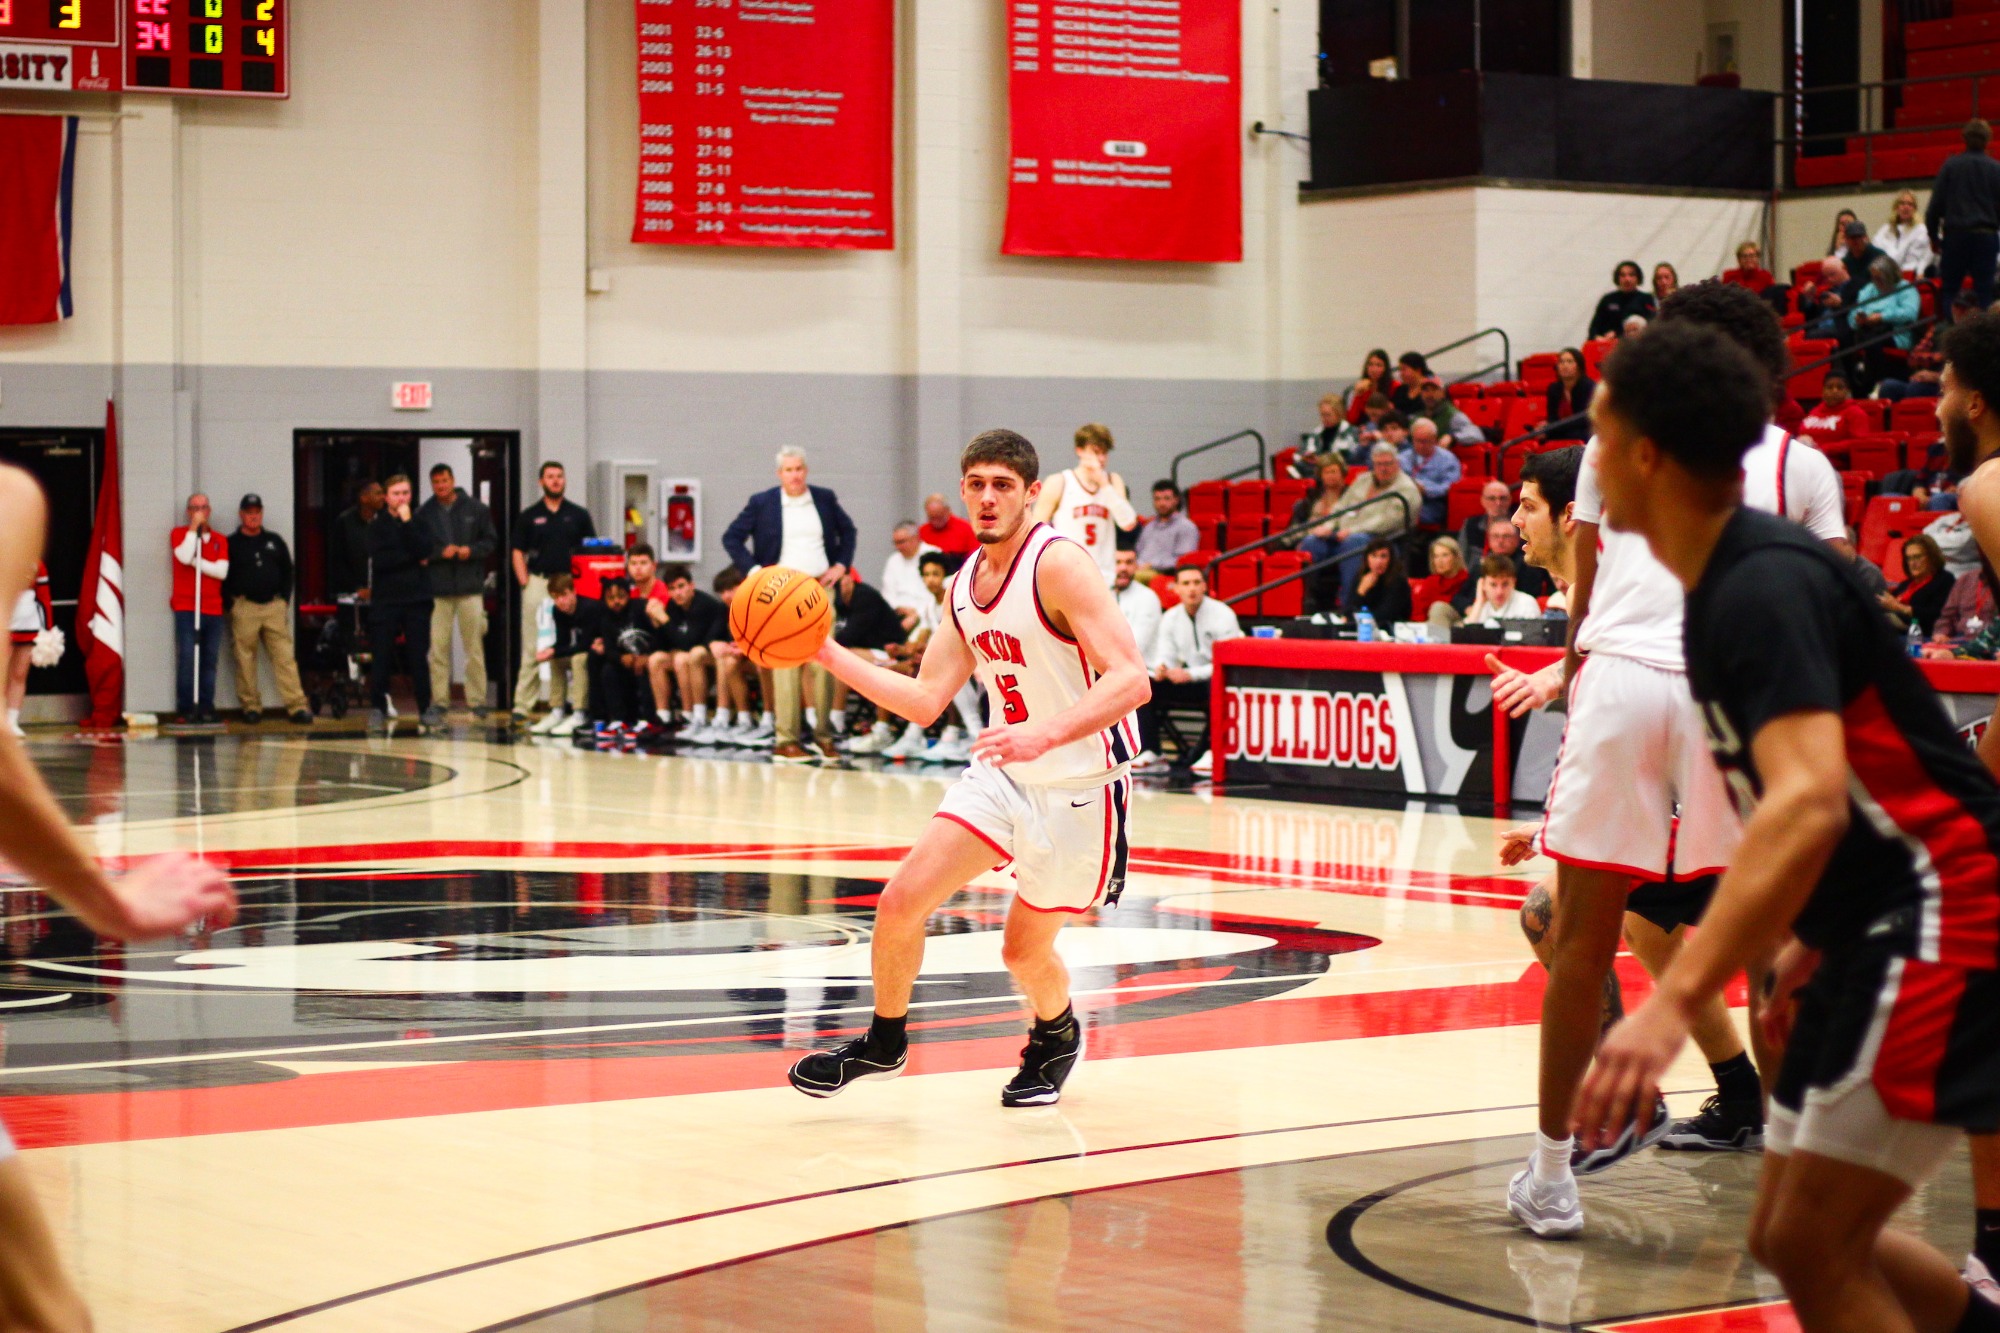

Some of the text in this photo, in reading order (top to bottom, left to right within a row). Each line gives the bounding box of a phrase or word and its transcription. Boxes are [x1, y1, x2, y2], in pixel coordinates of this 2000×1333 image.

[641, 23, 671, 35] 2001
[136, 21, 275, 56] 34 0 4
[641, 42, 672, 55] 2002
[0, 53, 68, 81] SITY
[641, 61, 672, 74] 2003
[641, 80, 673, 92] 2004
[641, 124, 673, 137] 2005
[642, 162, 673, 174] 2007
[401, 384, 427, 408] EXIT
[1085, 524, 1097, 546] 5
[1223, 690, 1397, 766] BULLDOGS
